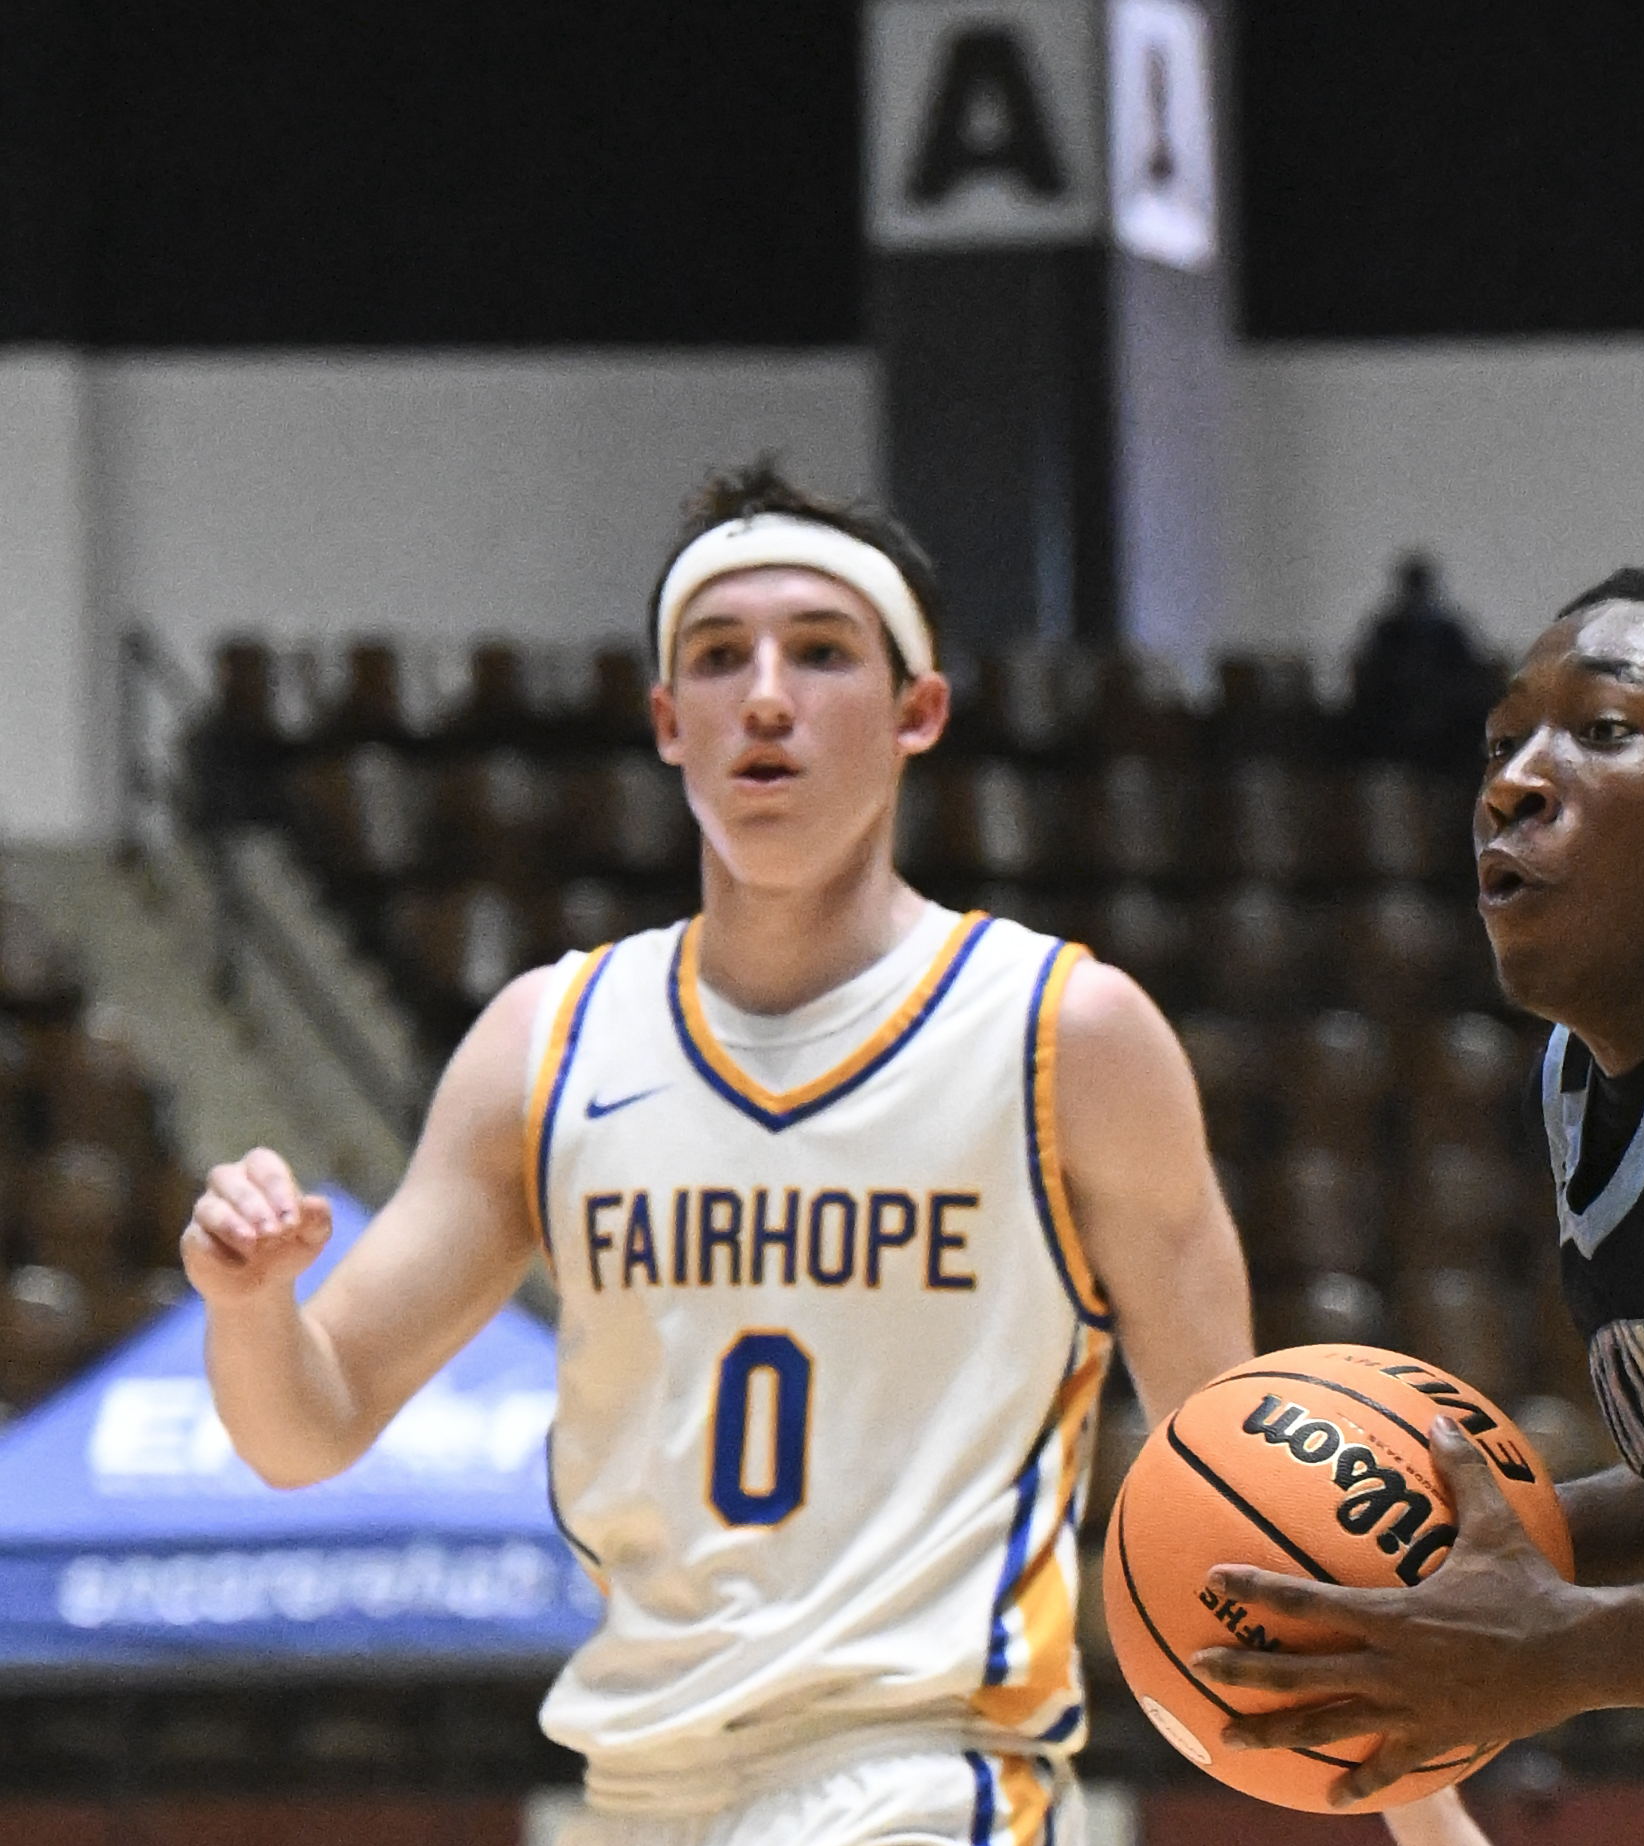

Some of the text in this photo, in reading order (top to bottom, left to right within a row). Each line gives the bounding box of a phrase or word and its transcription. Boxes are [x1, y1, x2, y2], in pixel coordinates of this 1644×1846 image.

[903, 22, 1070, 203] A
[583, 1186, 982, 1292] FAIRHOPE
[703, 1324, 816, 1533] 0
